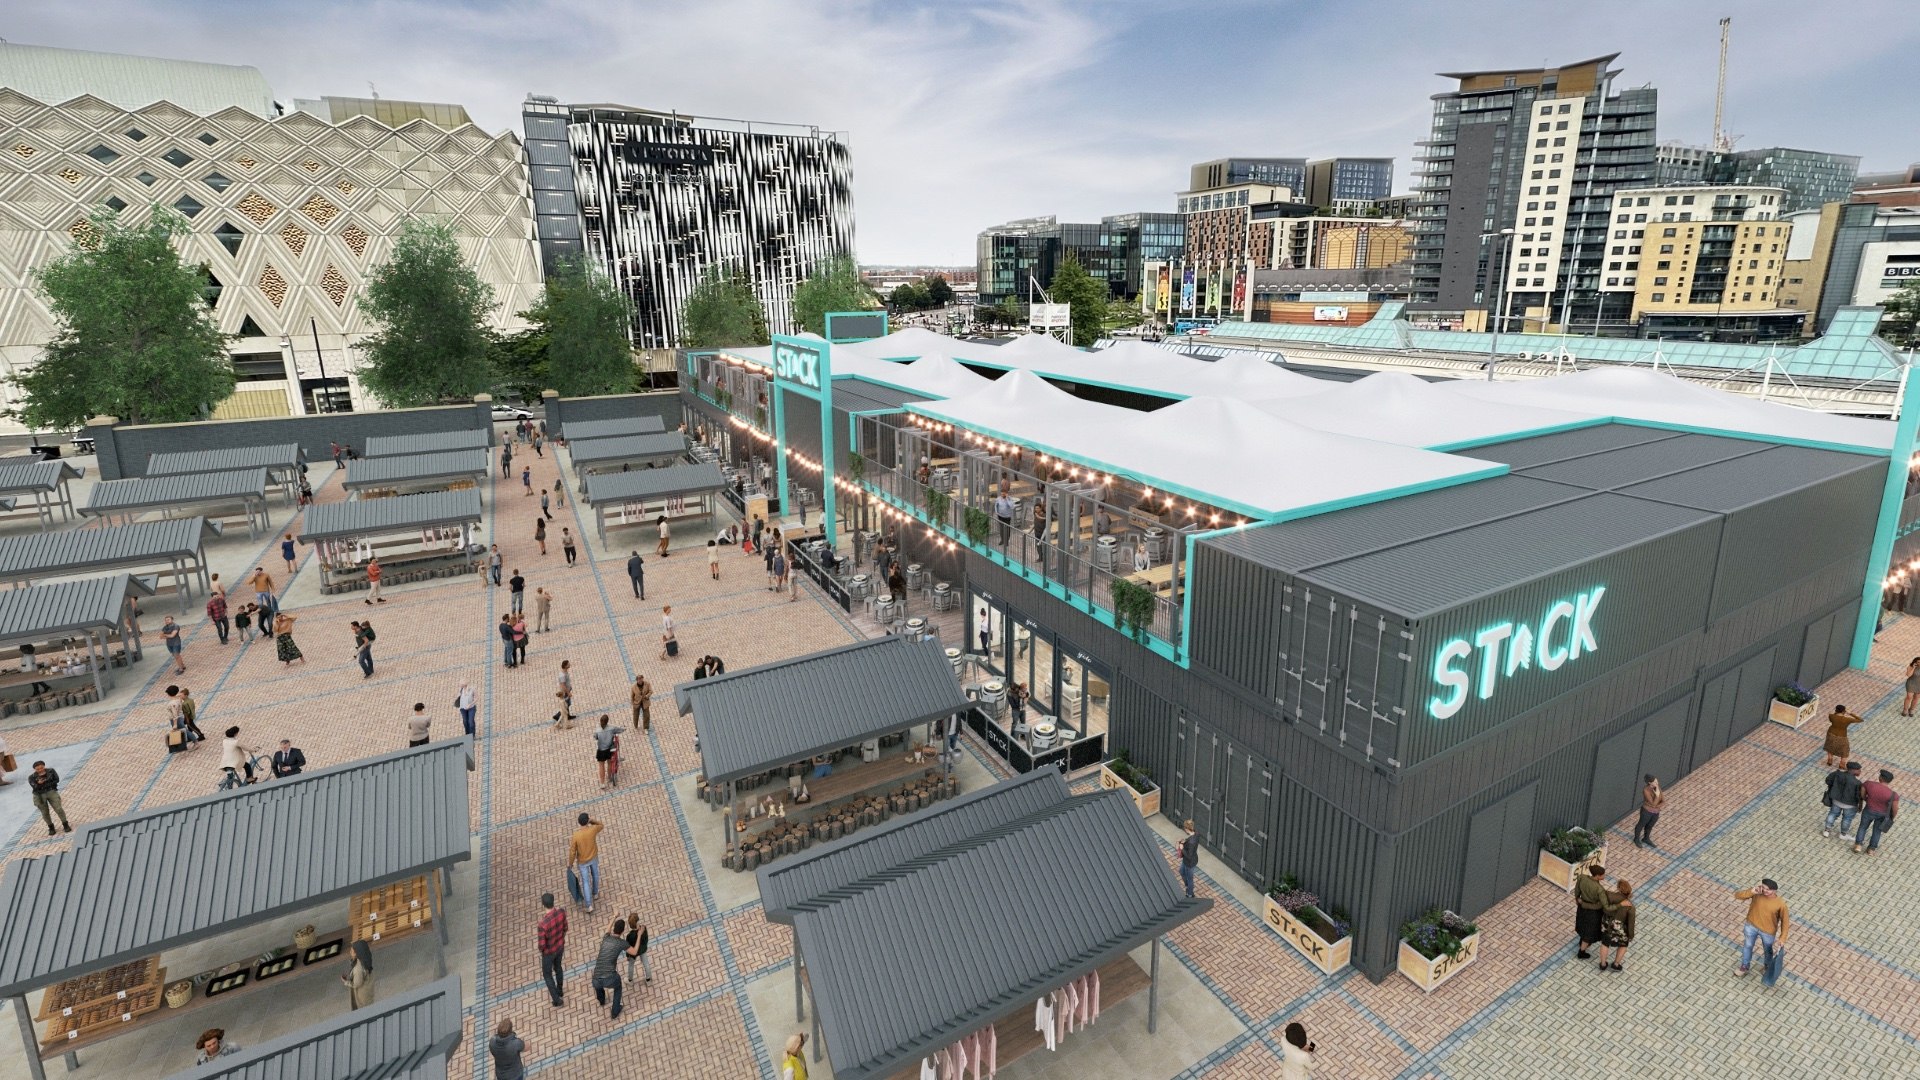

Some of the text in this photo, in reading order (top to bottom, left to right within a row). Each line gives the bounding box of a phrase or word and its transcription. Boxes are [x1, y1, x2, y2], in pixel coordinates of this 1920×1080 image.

[632, 146, 709, 161] VICTORIA
[776, 347, 819, 387] STACK
[1428, 586, 1607, 720] STACK
[988, 730, 1008, 751] STACK
[1270, 908, 1324, 962] STACK
